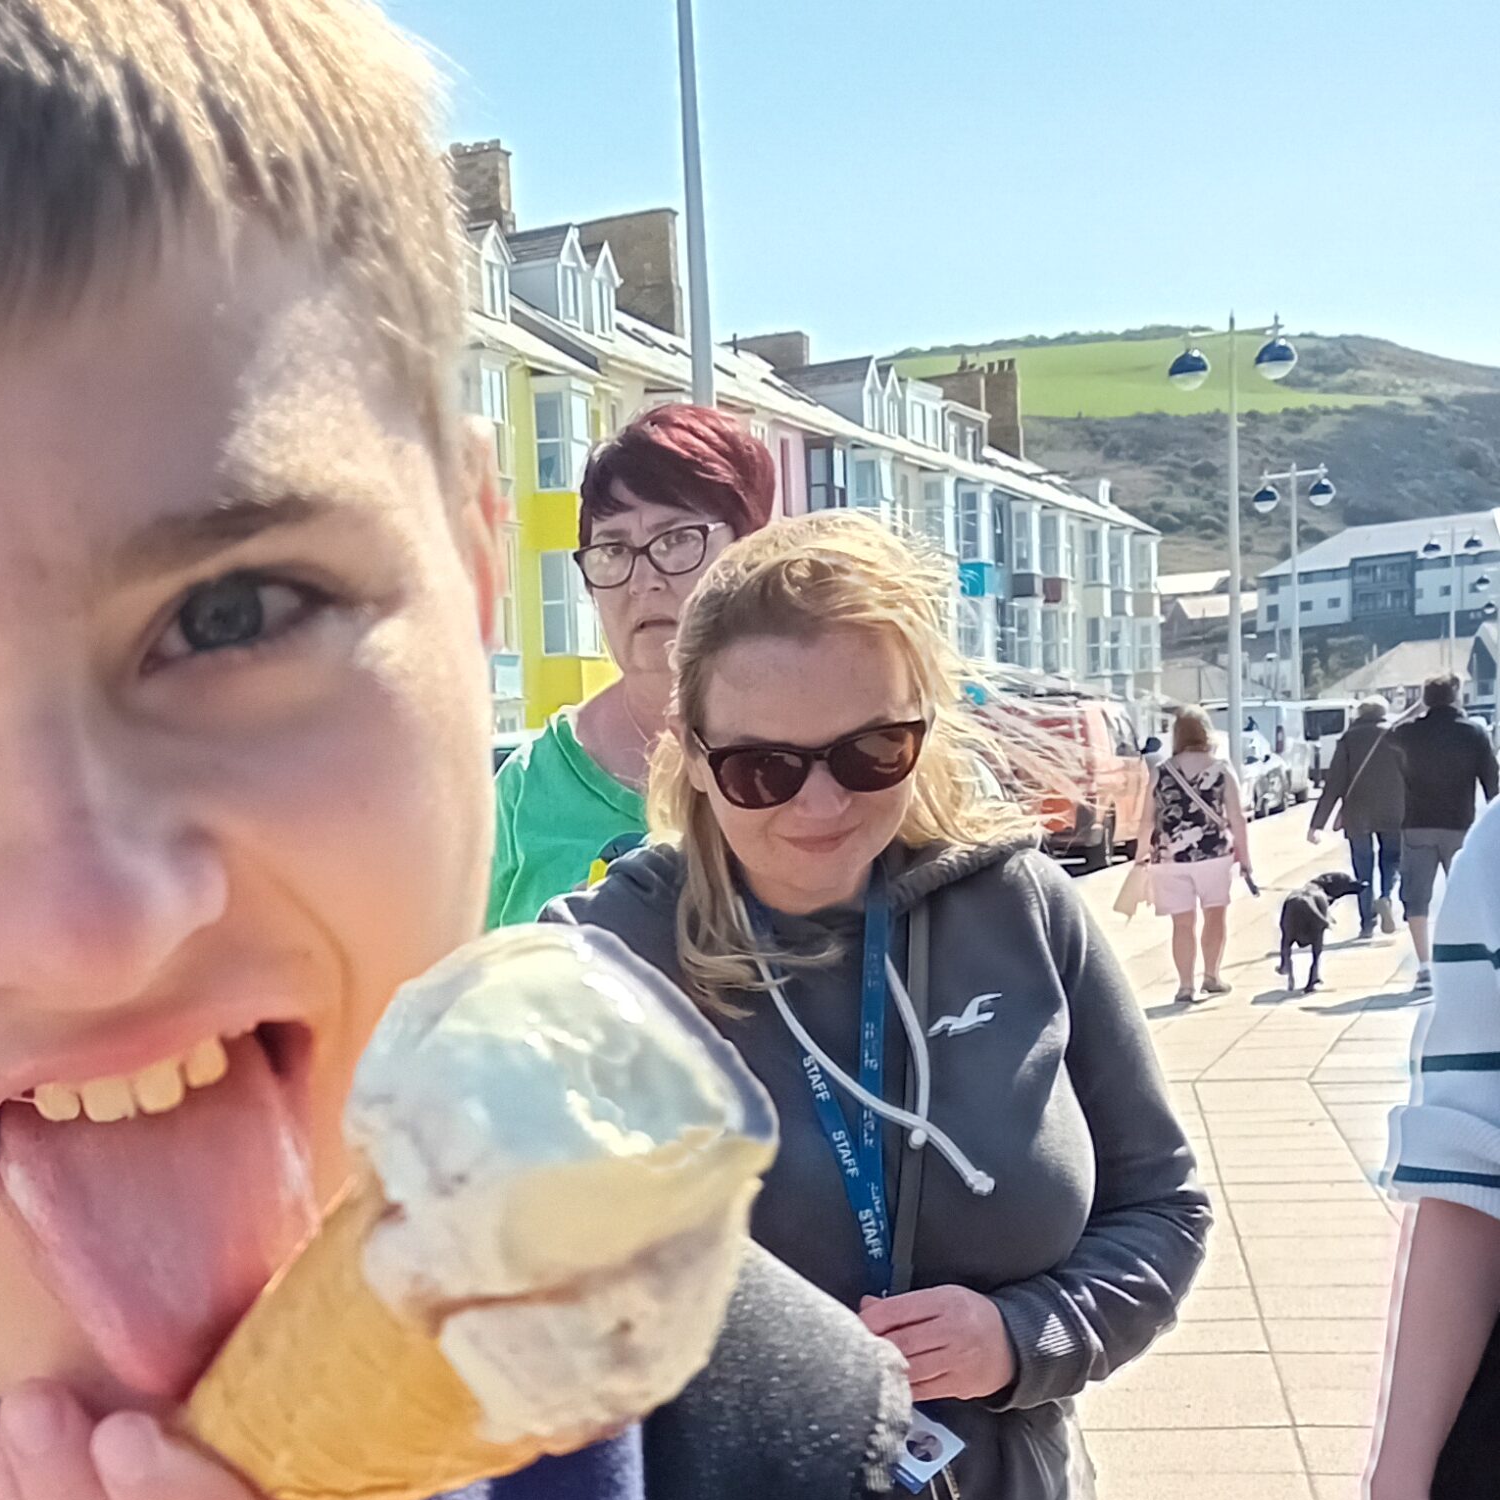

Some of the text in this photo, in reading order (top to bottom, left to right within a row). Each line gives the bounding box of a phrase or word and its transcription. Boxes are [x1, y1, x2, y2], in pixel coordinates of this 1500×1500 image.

[802, 1055, 831, 1102] STAFF
[832, 1130, 860, 1178] STAFF
[858, 1208, 883, 1259] STAFF
